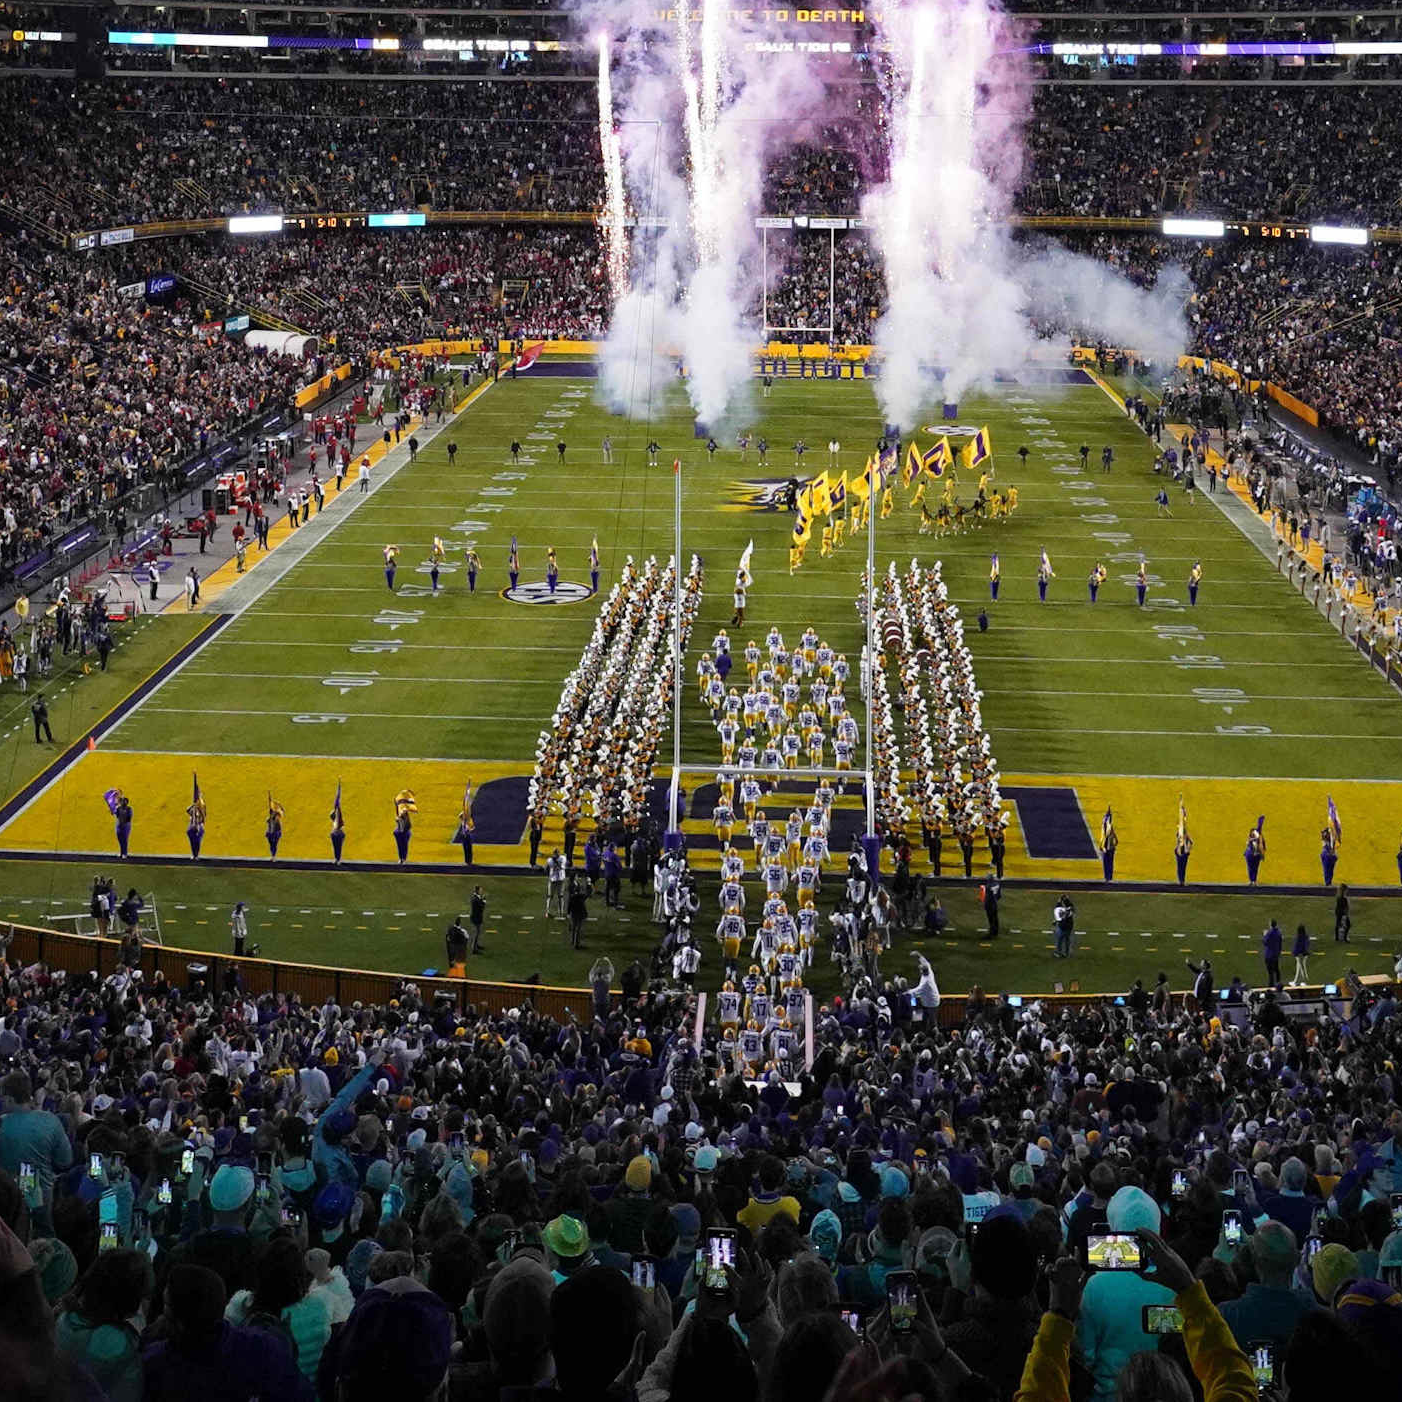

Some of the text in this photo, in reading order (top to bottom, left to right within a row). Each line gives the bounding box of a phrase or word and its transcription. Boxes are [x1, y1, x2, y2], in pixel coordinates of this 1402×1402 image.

[796, 9, 865, 23] DEATH
[321, 669, 381, 688] 10
[1191, 687, 1251, 705] 10
[1214, 724, 1273, 736] 5
[801, 871, 813, 883] 57
[781, 959, 794, 972] 30
[724, 997, 738, 1010] 74
[789, 994, 803, 1007] 97
[755, 1003, 766, 1016] 17
